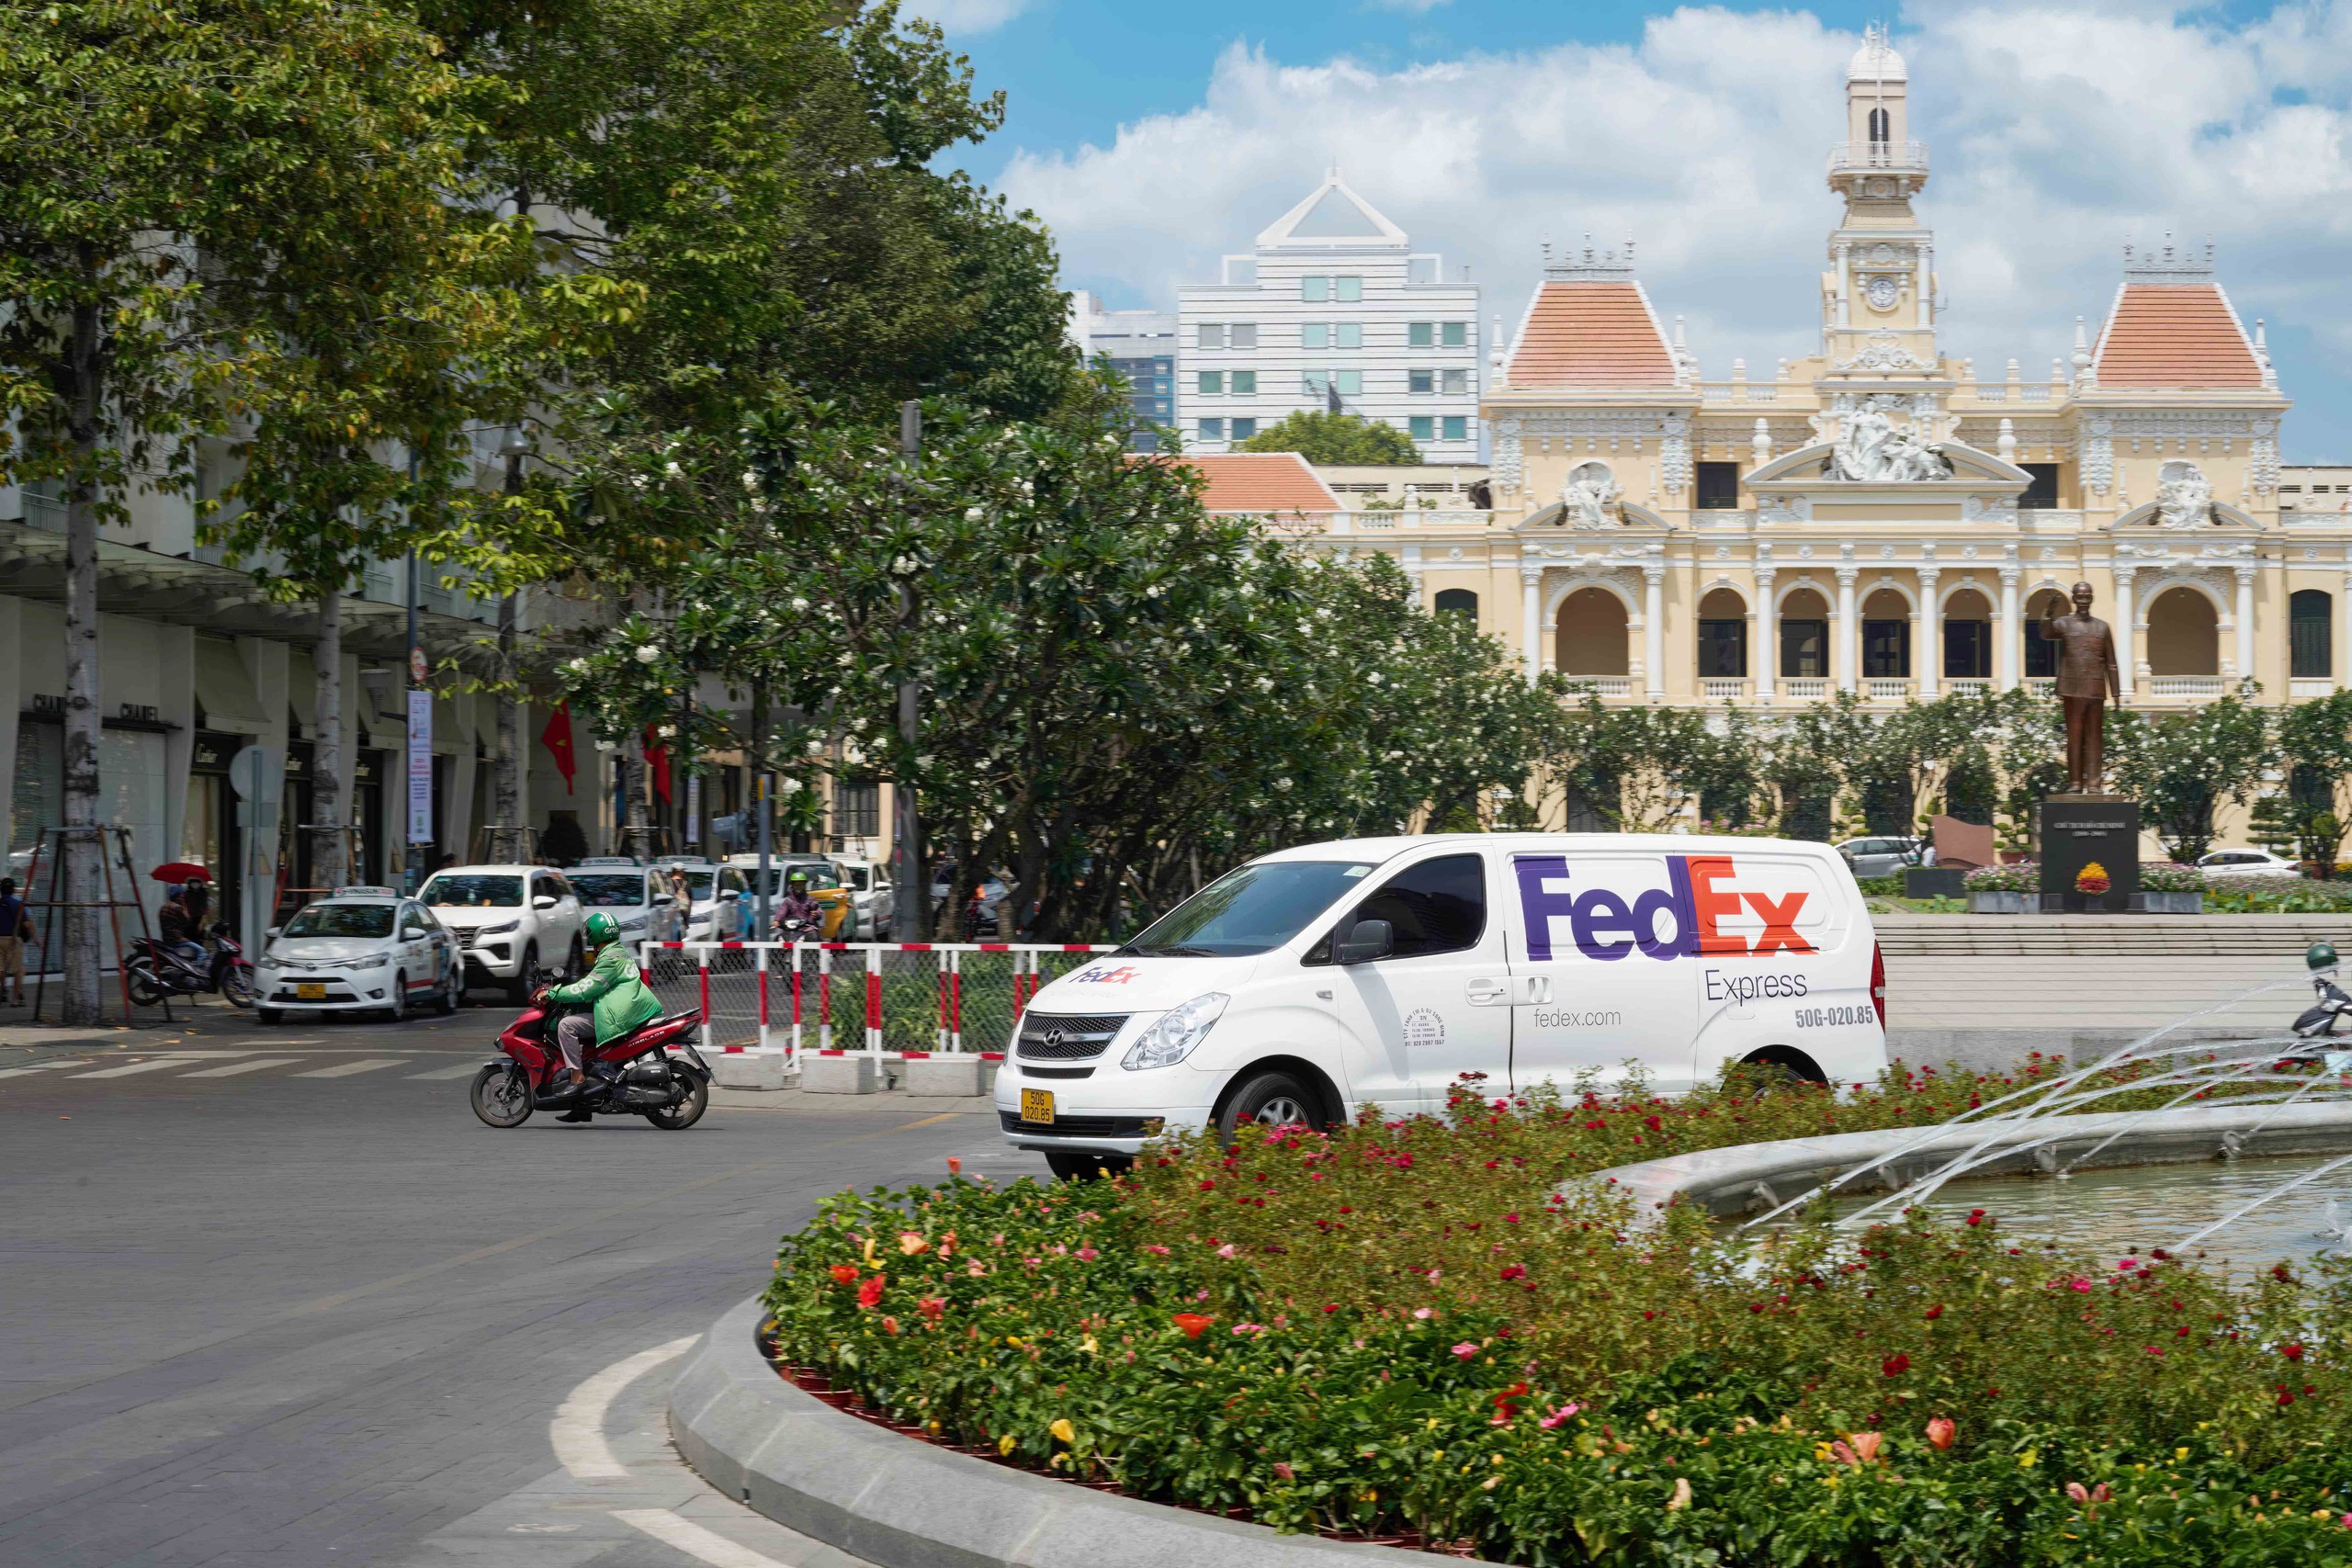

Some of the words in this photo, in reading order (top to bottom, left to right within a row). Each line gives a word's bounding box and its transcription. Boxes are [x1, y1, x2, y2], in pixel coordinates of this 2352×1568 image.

[1513, 855, 1820, 962] FedEx
[1069, 966, 1143, 985] FedEx
[1705, 969, 1808, 1007] Express
[1533, 1008, 1622, 1028] fedex.com
[1794, 1006, 1873, 1028] 50G-020.85
[1030, 1091, 1045, 1105] 50G
[1024, 1106, 1050, 1122] 020.85
